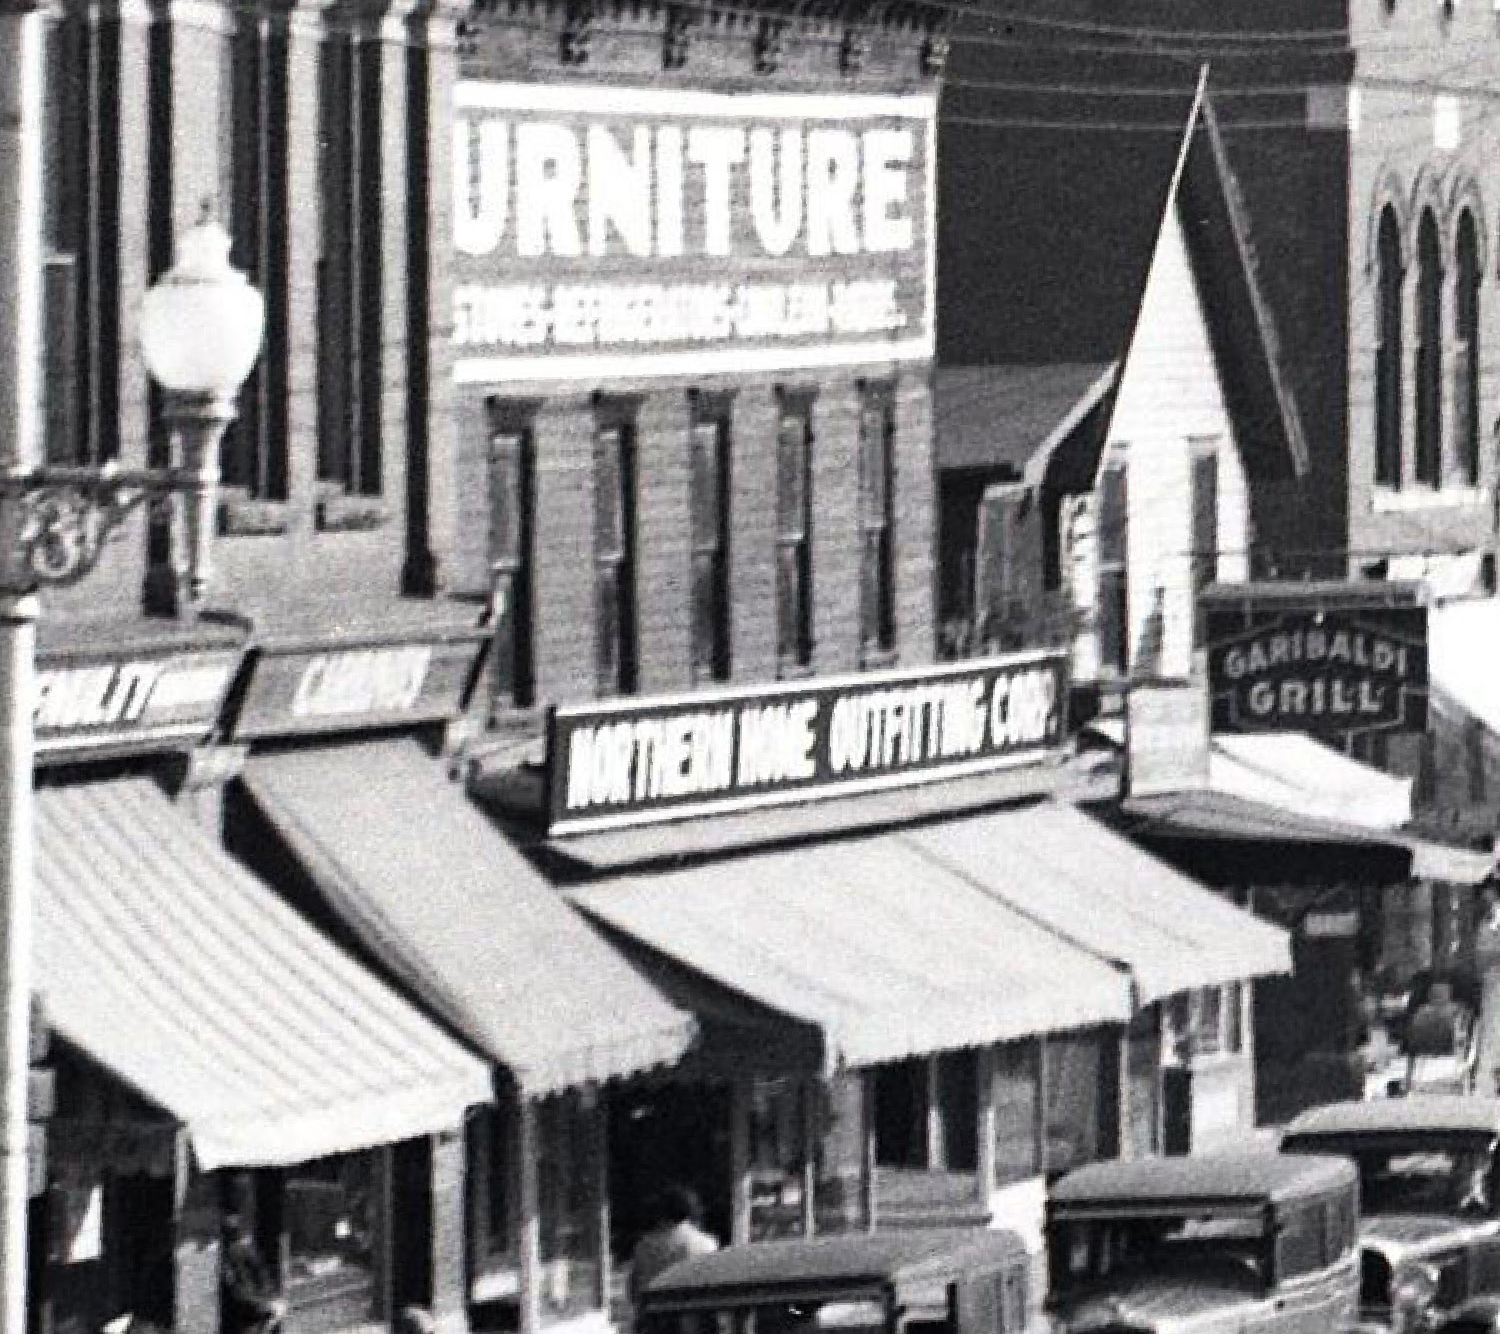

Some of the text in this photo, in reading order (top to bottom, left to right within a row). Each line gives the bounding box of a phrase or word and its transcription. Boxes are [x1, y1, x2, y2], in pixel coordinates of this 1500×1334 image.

[1225, 628, 1407, 678] GARIBALDI
[1249, 680, 1385, 716] GRILL
[566, 709, 733, 809] NORTHERN
[828, 672, 986, 772] OUTFITTING
